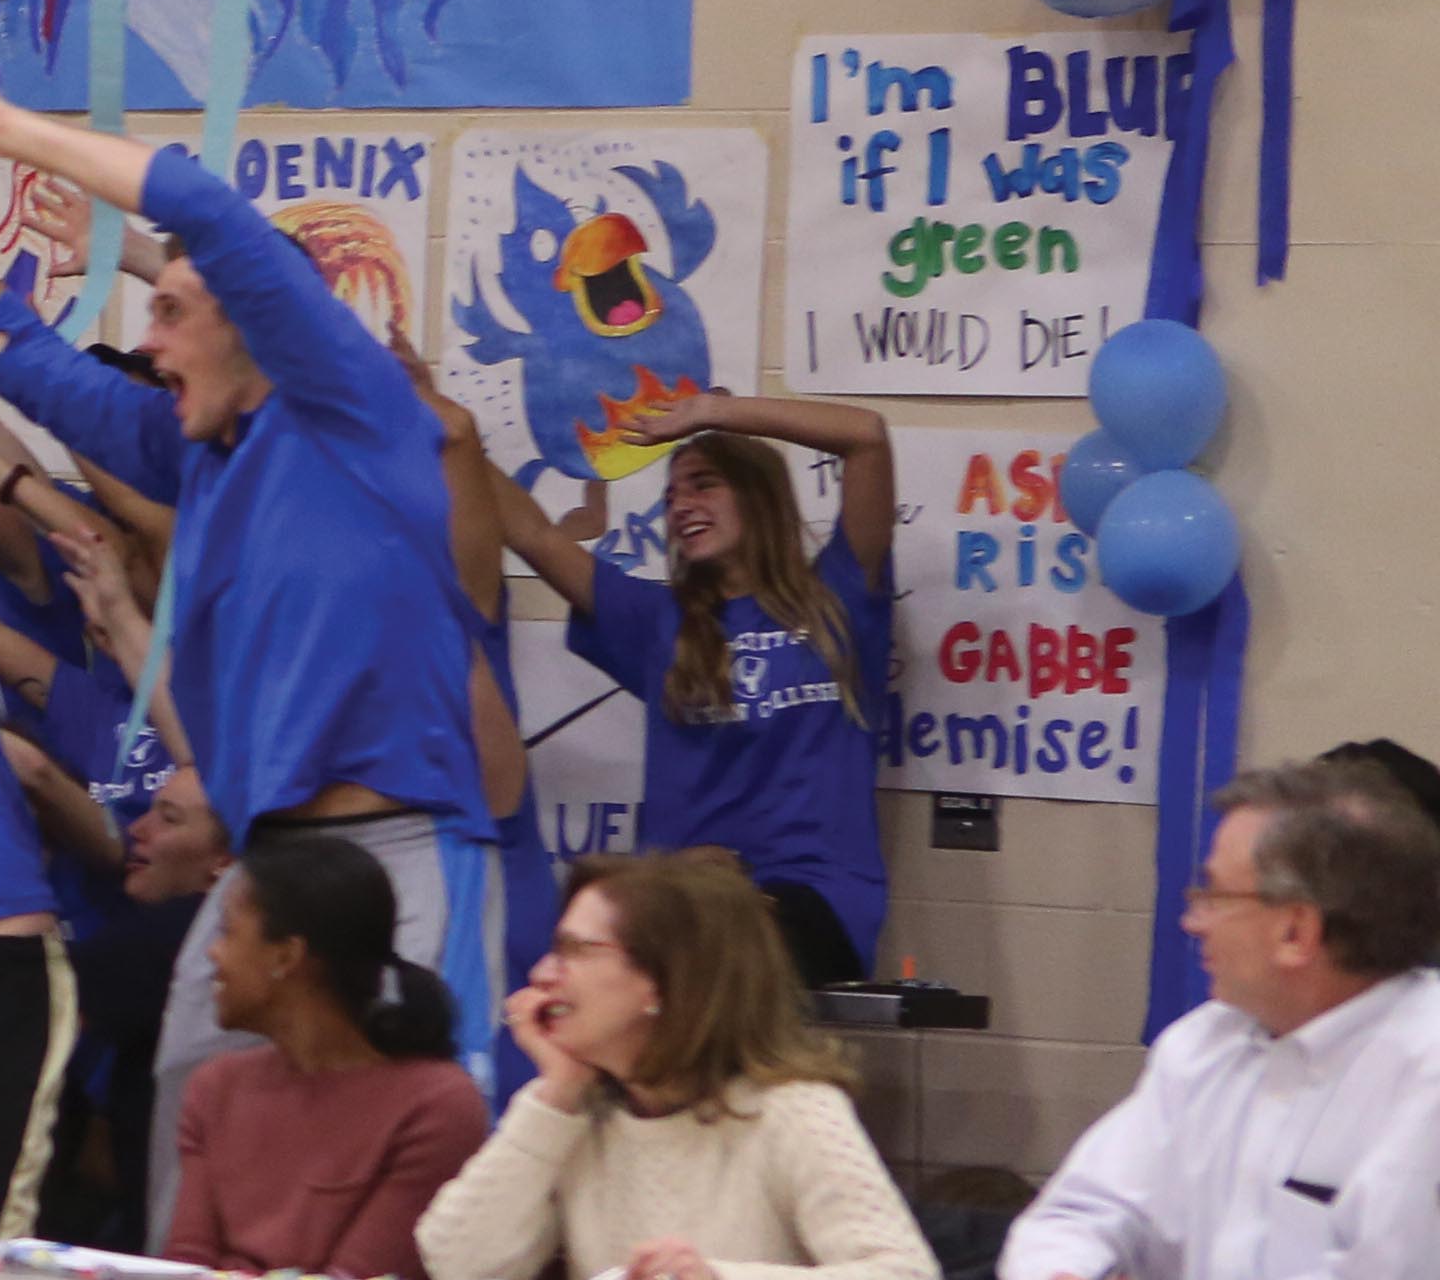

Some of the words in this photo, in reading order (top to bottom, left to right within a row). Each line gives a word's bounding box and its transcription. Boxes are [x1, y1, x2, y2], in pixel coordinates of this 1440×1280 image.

[983, 144, 1129, 204] was
[882, 216, 1079, 297] green
[854, 308, 990, 374] WOULD
[939, 621, 1136, 699] GABBE
